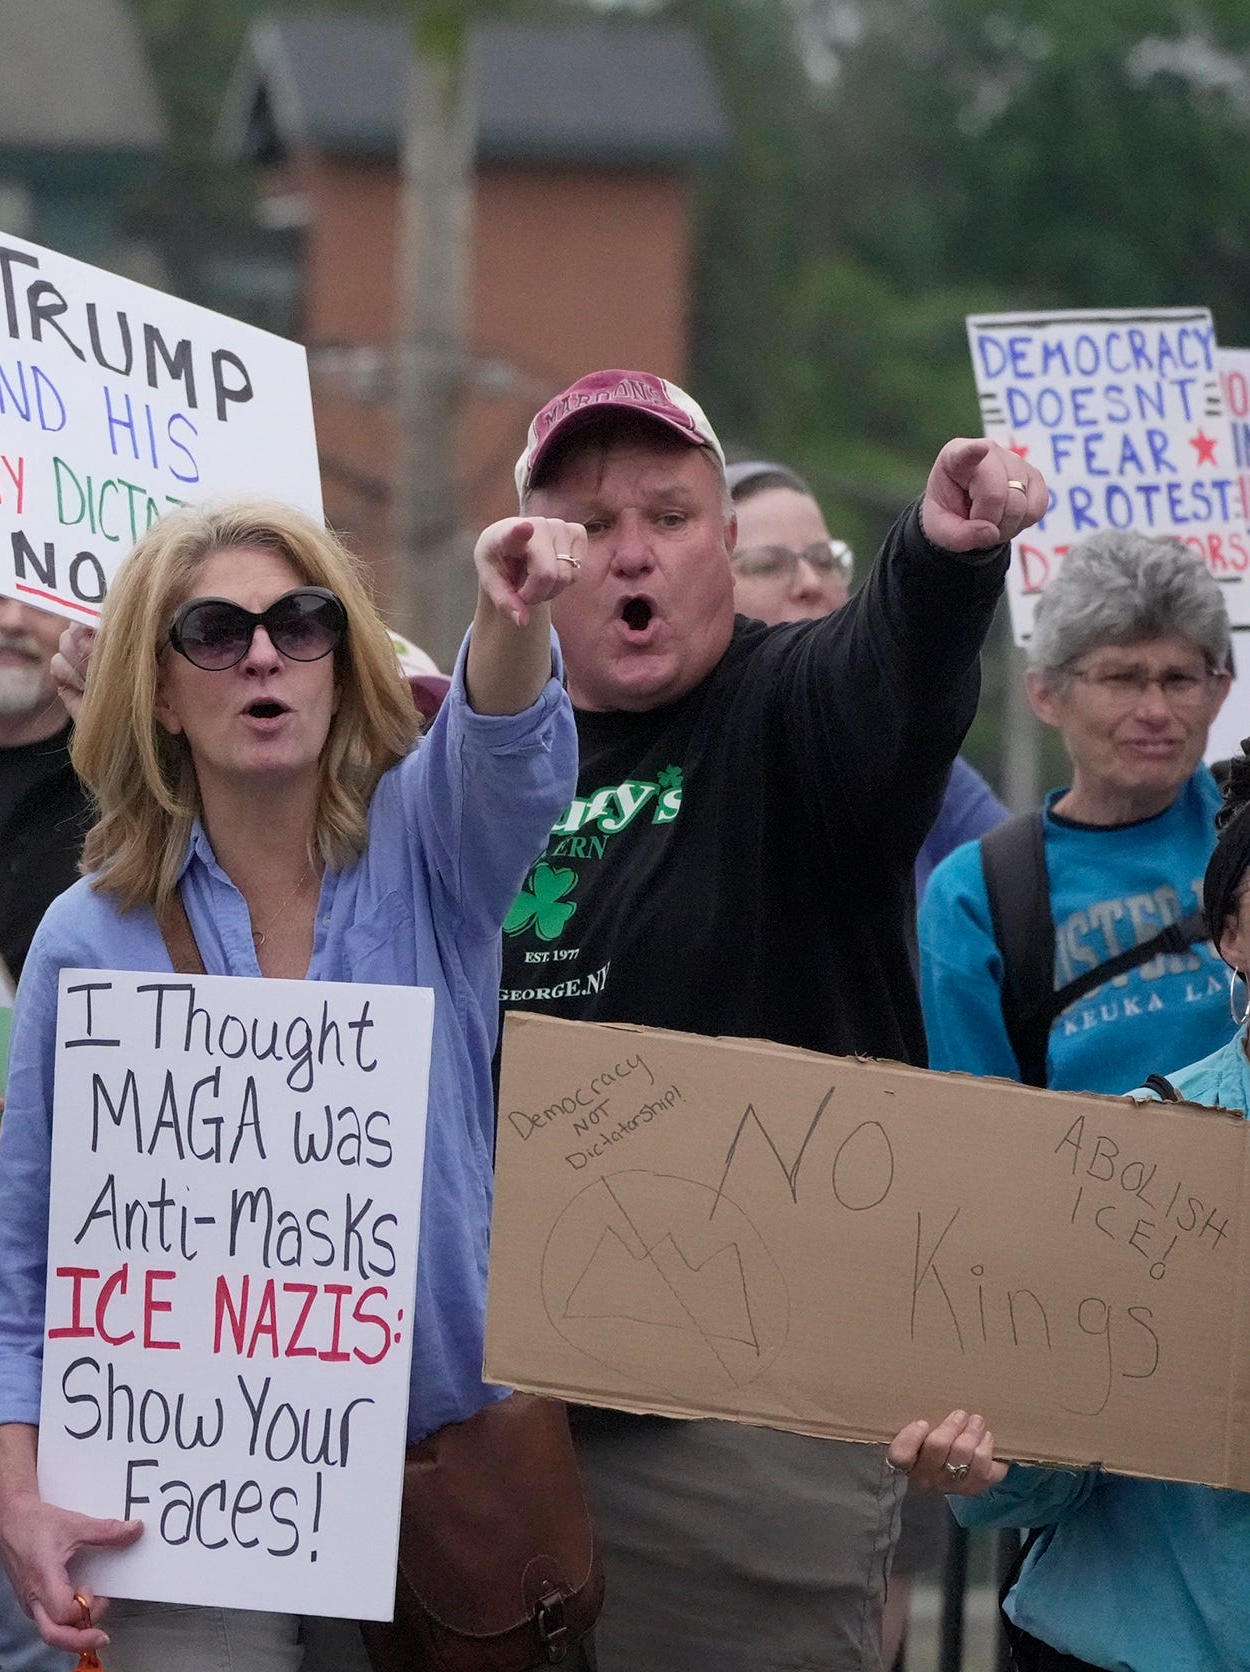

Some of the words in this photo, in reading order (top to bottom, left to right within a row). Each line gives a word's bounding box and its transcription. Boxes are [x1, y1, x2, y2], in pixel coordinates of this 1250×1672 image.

[976, 326, 1216, 380] DEMOCRACY
[103, 385, 200, 484] HIS
[1050, 429, 1178, 477] FEAR
[52, 455, 192, 545] DICTA
[11, 529, 107, 603] NO
[65, 982, 121, 1049] I
[136, 983, 378, 1093] Thought
[91, 1066, 268, 1164] MAGA
[507, 1052, 656, 1142] Democracy
[564, 1085, 688, 1171] Dictatorship!
[571, 1098, 612, 1137] NOT
[709, 1086, 895, 1221] NO
[1054, 1114, 1230, 1250] ABOLISH
[1070, 1186, 1179, 1281] ICE!
[48, 1263, 181, 1350] ICE
[213, 1274, 405, 1366] NAZIS:
[909, 1207, 1160, 1416] Kings
[61, 1356, 225, 1450] Show
[237, 1374, 376, 1469] Your
[123, 1458, 324, 1564] Faces!
